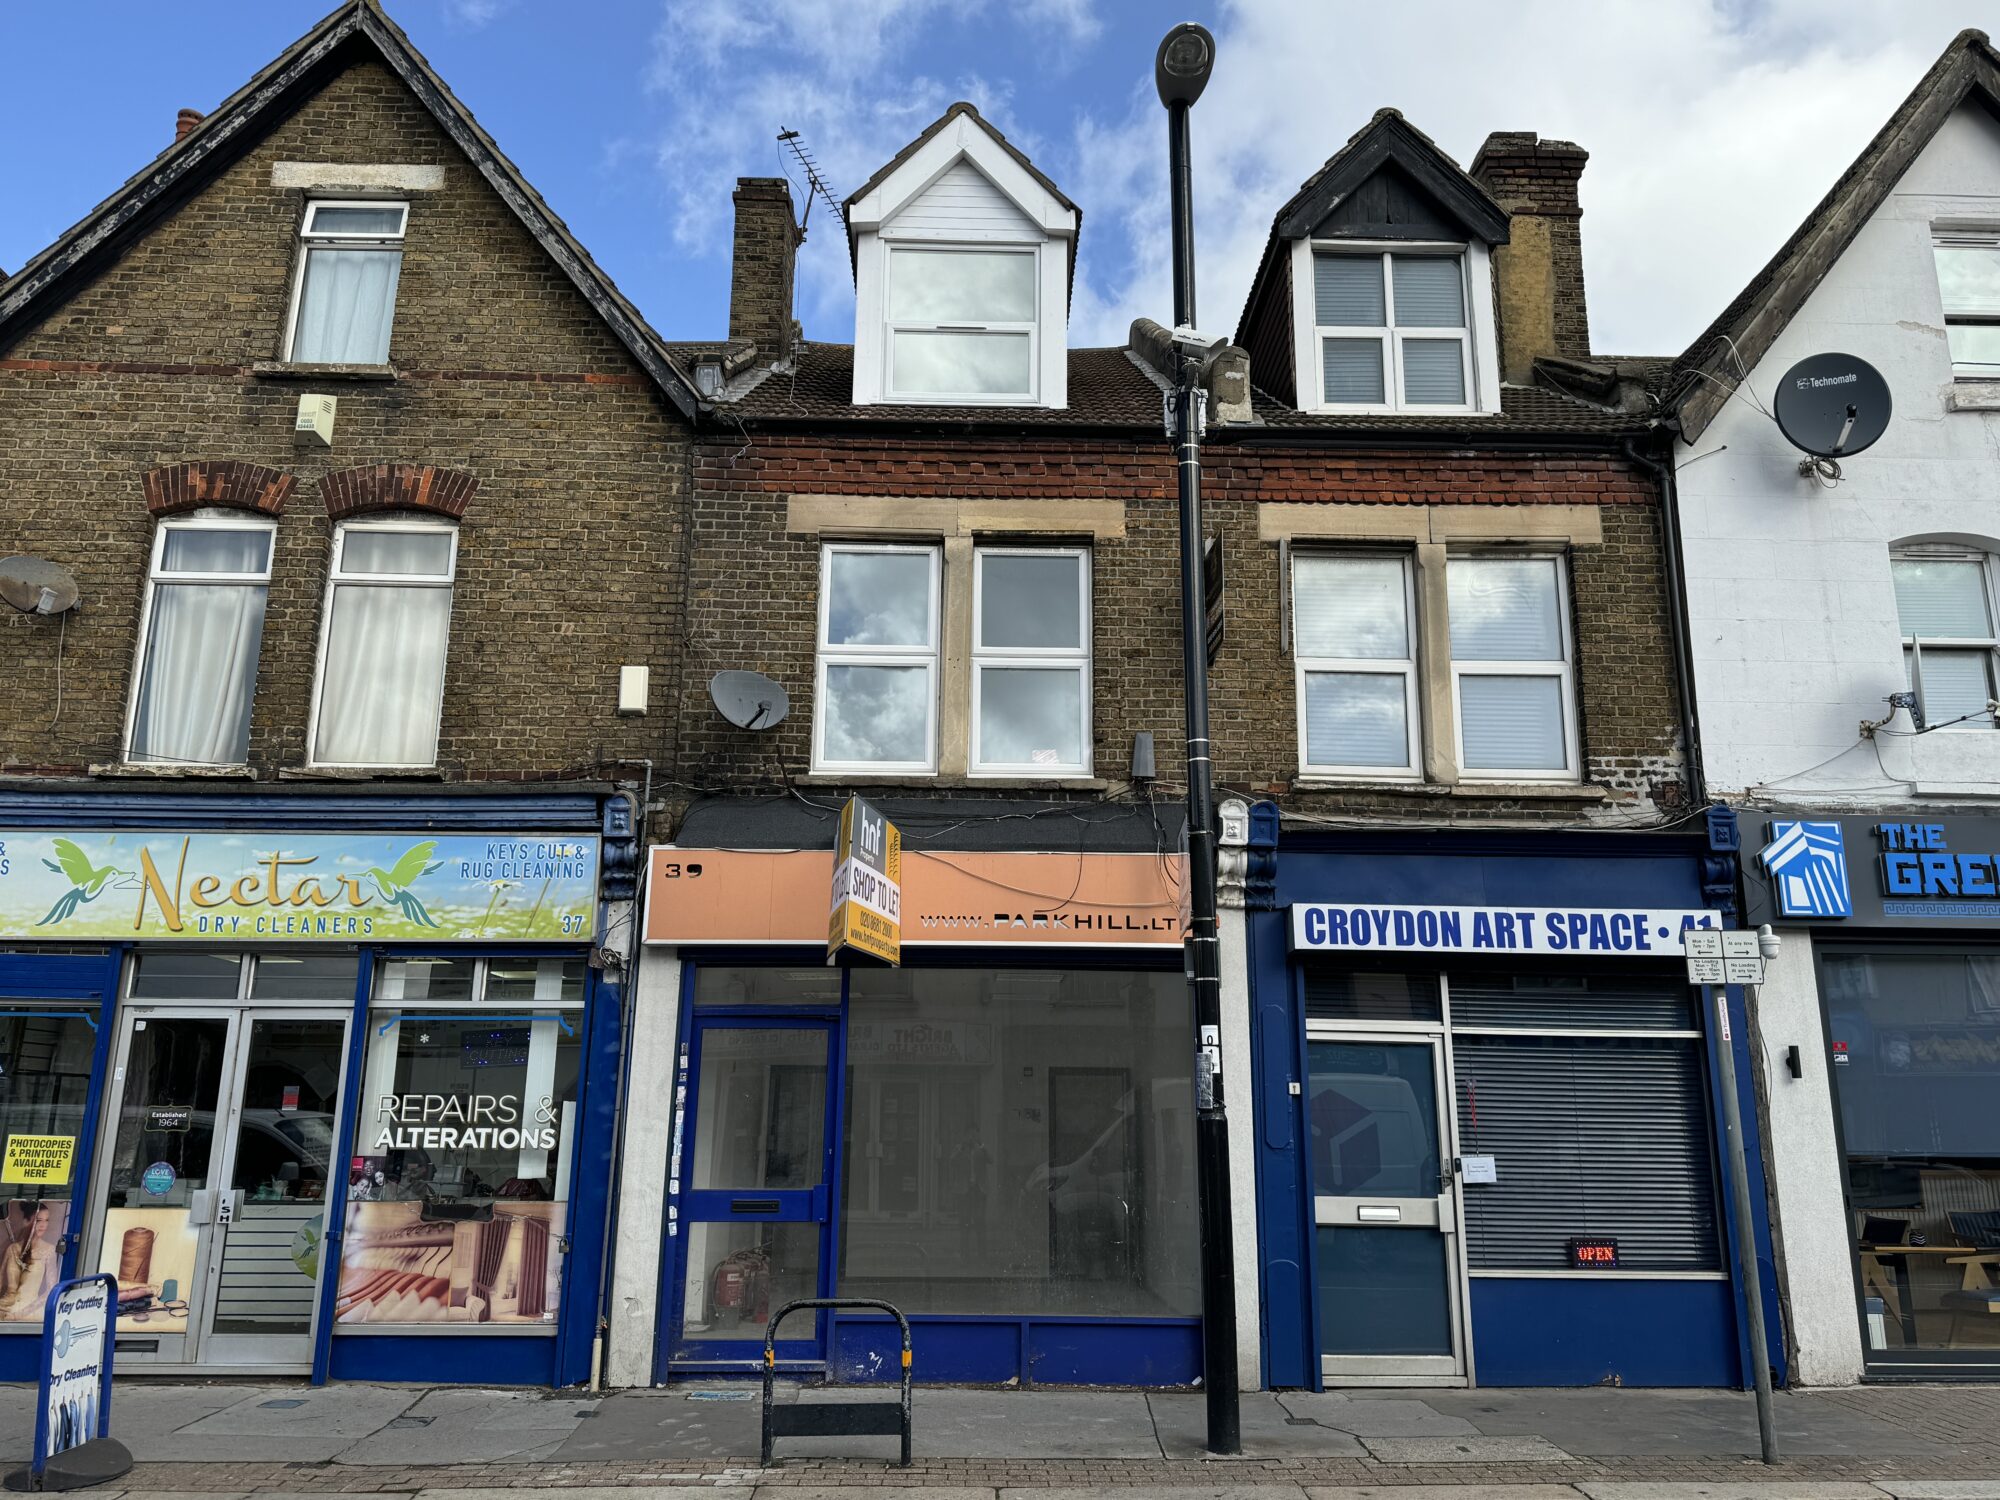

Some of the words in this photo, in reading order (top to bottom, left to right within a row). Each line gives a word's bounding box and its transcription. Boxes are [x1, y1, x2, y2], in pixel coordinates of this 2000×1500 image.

[1810, 373, 1857, 388] Technomate
[860, 806, 881, 857] hnf
[1879, 823, 1947, 849] THE
[486, 844, 528, 860] KEYS
[536, 844, 568, 860] CUT
[575, 845, 585, 860] &
[461, 862, 493, 878] RUG
[501, 862, 584, 878] CLEANING
[665, 863, 702, 878] 39
[1884, 853, 2000, 895] GRE
[134, 835, 374, 932] Nectar
[852, 866, 876, 904] SHOP
[877, 880, 887, 911] TO
[888, 886, 899, 918] LET
[198, 916, 240, 933] DRY
[256, 916, 373, 934] CLEANERS
[562, 916, 583, 934] 37
[1304, 907, 1462, 947] CROYDON
[1472, 911, 1536, 949] ART
[1545, 912, 1652, 951] SPACE
[850, 927, 899, 958] www.hnfproperty.com
[469, 1048, 528, 1061] CUTTING
[377, 1095, 519, 1123] REPAIRS
[534, 1095, 559, 1124] &
[158, 1119, 178, 1127] 1964
[9, 1139, 72, 1149] PHOTOCOPIES
[374, 1127, 556, 1150] ALTERATIONS
[9, 1148, 16, 1157] &
[18, 1149, 69, 1159] PRINTOUTS
[13, 1159, 62, 1169] AVAILABLE
[151, 1168, 169, 1176] LOVE
[23, 1169, 48, 1178] HERE
[1578, 1247, 1613, 1260] OPEN
[58, 1301, 75, 1315] Key
[75, 1296, 103, 1311] Cutting
[50, 1374, 63, 1387] Dry
[64, 1364, 98, 1382] Cleaning
